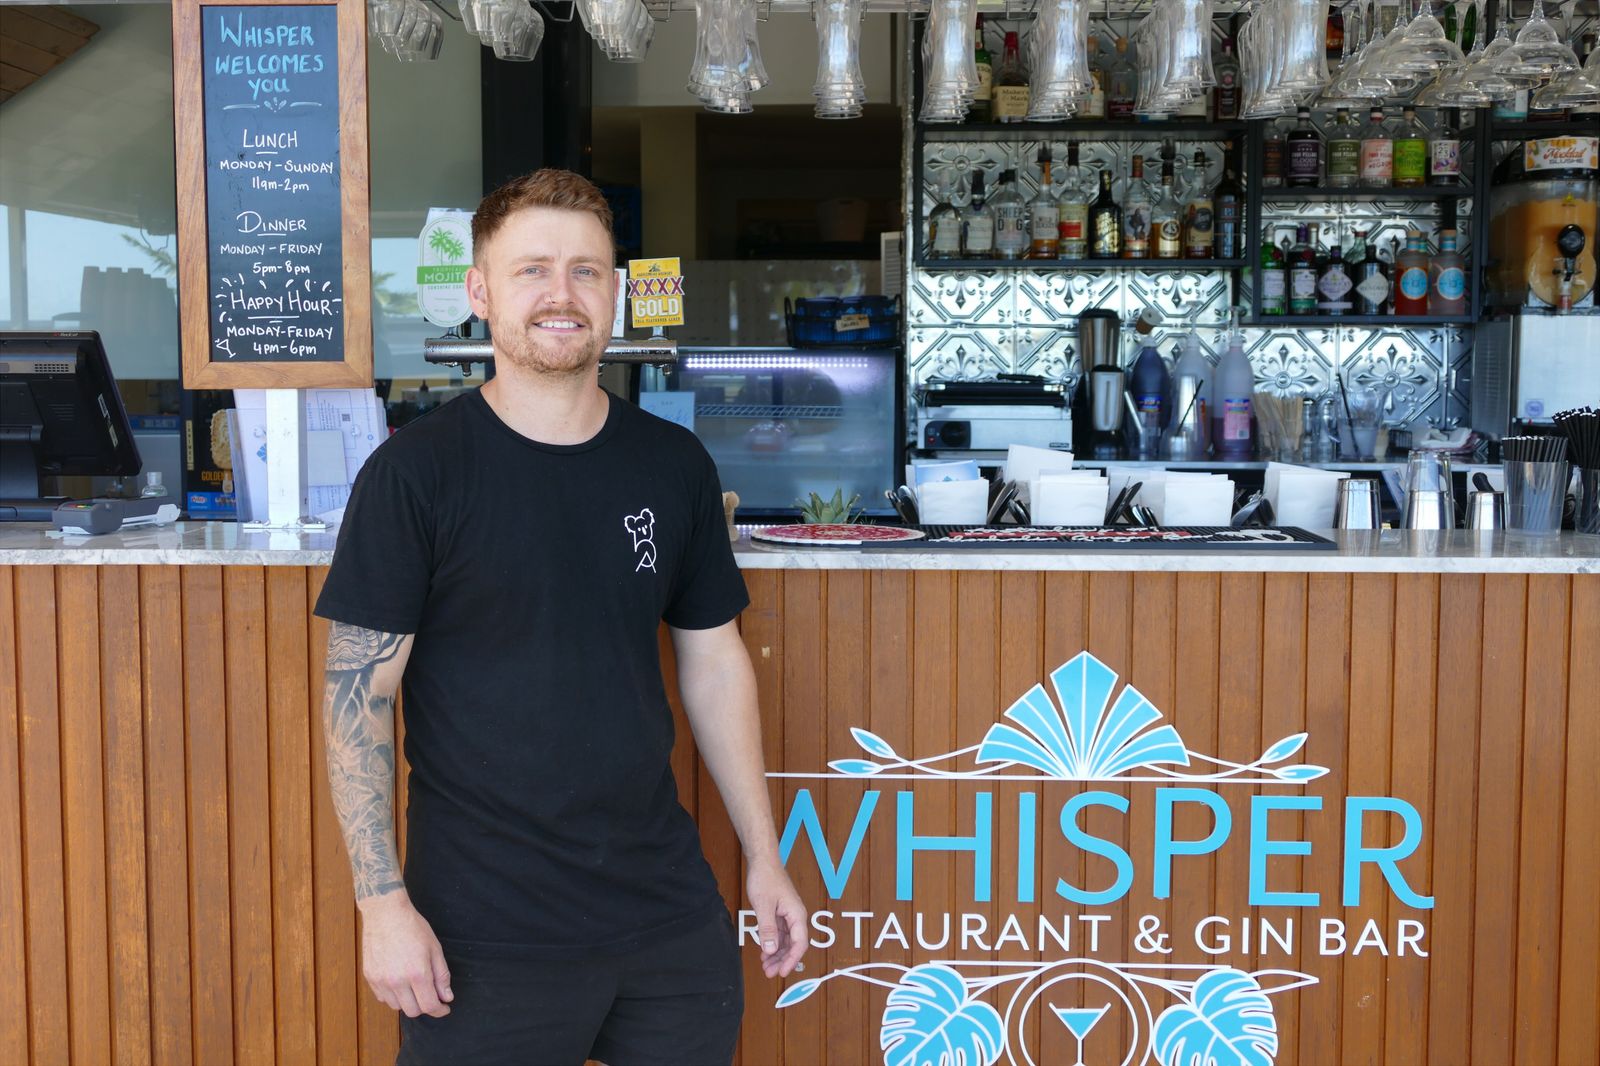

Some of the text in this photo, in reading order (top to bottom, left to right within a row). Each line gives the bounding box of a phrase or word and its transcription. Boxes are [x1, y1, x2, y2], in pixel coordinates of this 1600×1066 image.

[220, 11, 315, 48] WHISPER
[215, 54, 324, 75] WELCOMES
[243, 129, 298, 149] LUNCH
[236, 211, 307, 233] DINNER
[627, 276, 685, 298] XXXX
[230, 289, 333, 316] HAPPY HOUR
[635, 298, 680, 317] GOLD
[778, 787, 1435, 909] WHISPER
[738, 909, 1429, 957] RSTAURANT & GIN BAR
